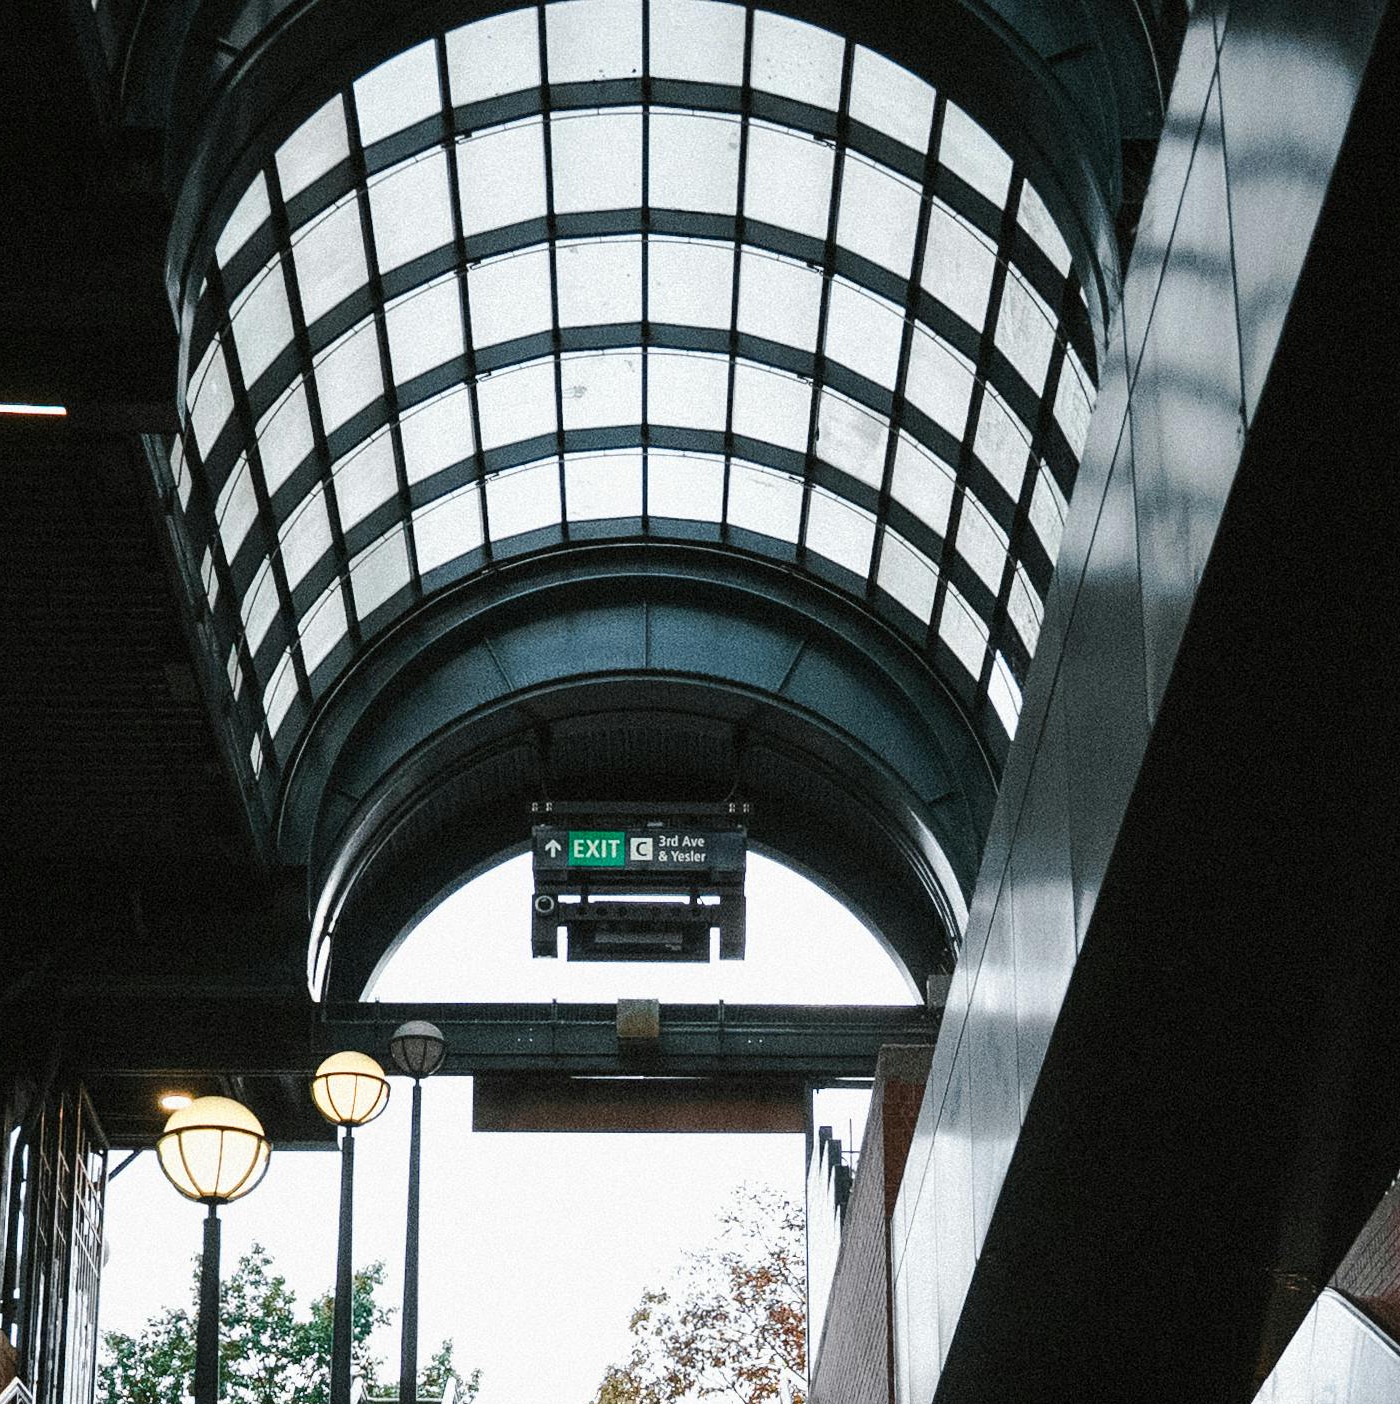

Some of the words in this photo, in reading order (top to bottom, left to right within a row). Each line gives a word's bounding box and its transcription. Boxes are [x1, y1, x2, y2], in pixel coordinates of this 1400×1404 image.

[659, 835, 678, 847] 3rd
[682, 835, 705, 847] Ave
[573, 839, 620, 858] EXIT
[635, 841, 647, 857] C
[658, 850, 668, 862] &
[670, 850, 706, 862] Yesler
